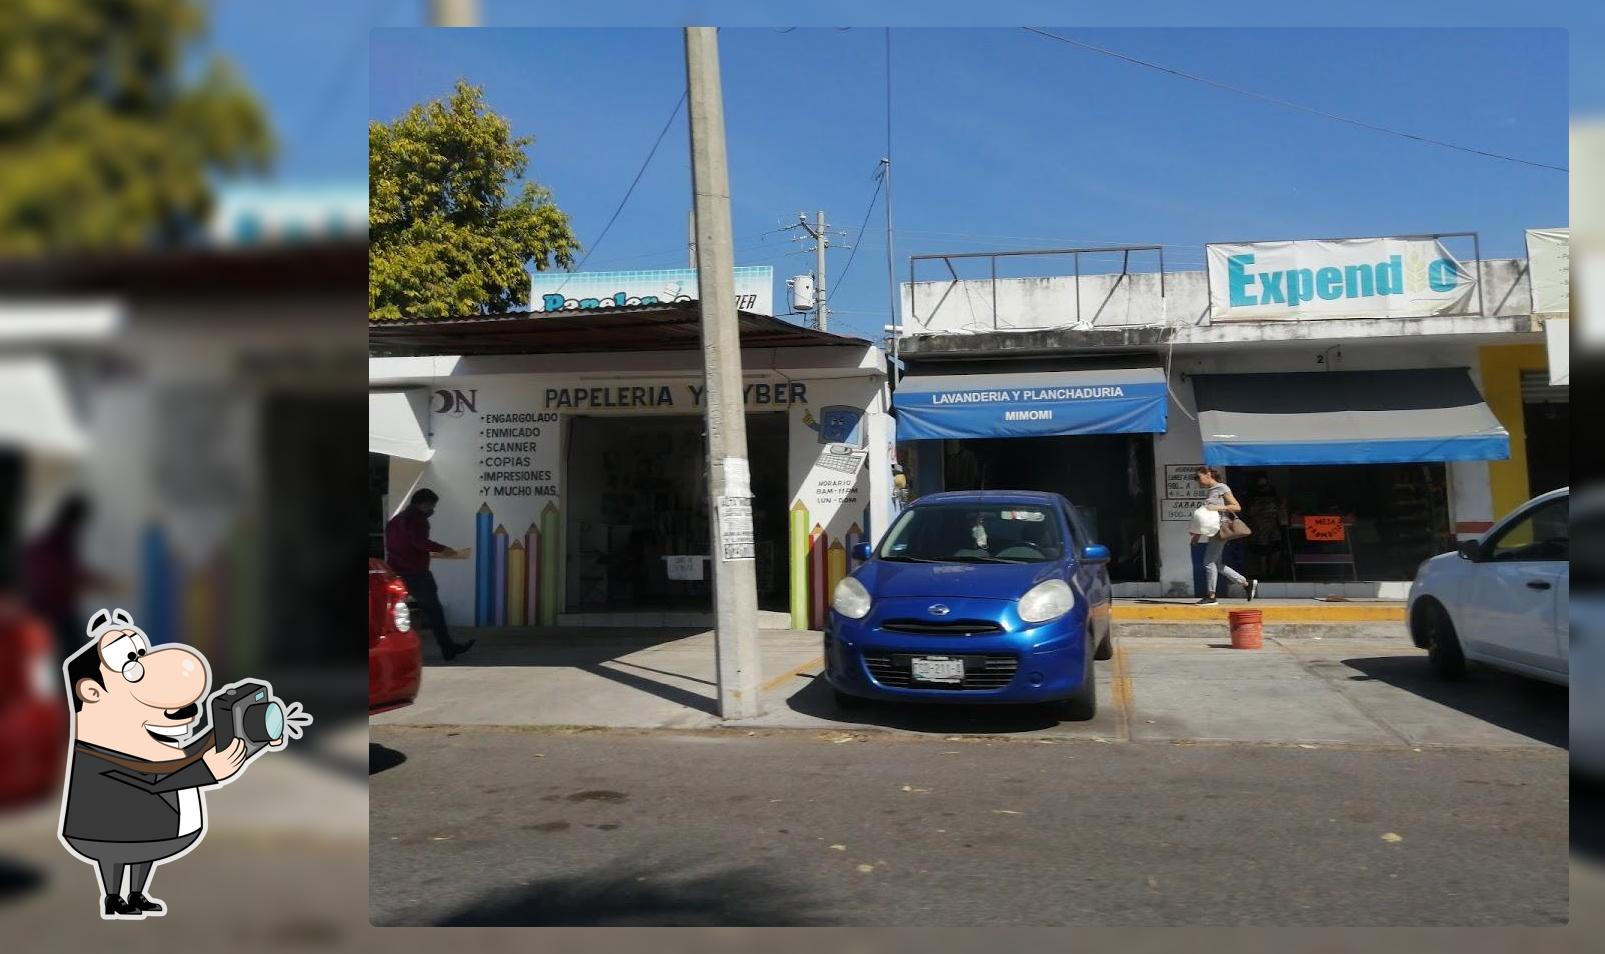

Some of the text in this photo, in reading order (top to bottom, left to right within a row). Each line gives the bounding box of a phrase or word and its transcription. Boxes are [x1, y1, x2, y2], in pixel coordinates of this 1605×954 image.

[545, 386, 674, 409] PAPELERIA
[743, 383, 808, 406] YBER
[932, 387, 1124, 405] LAVANDERIA Y PLANCHADURIA
[486, 413, 558, 424] ENGARGOLADO
[1005, 410, 1053, 422] MIMOMI
[486, 428, 541, 438] ENMICADO
[486, 442, 537, 453] SCANNER
[485, 457, 531, 467] COPIAS
[484, 471, 552, 481] IMPRESIONES
[494, 486, 532, 496] MUCHO
